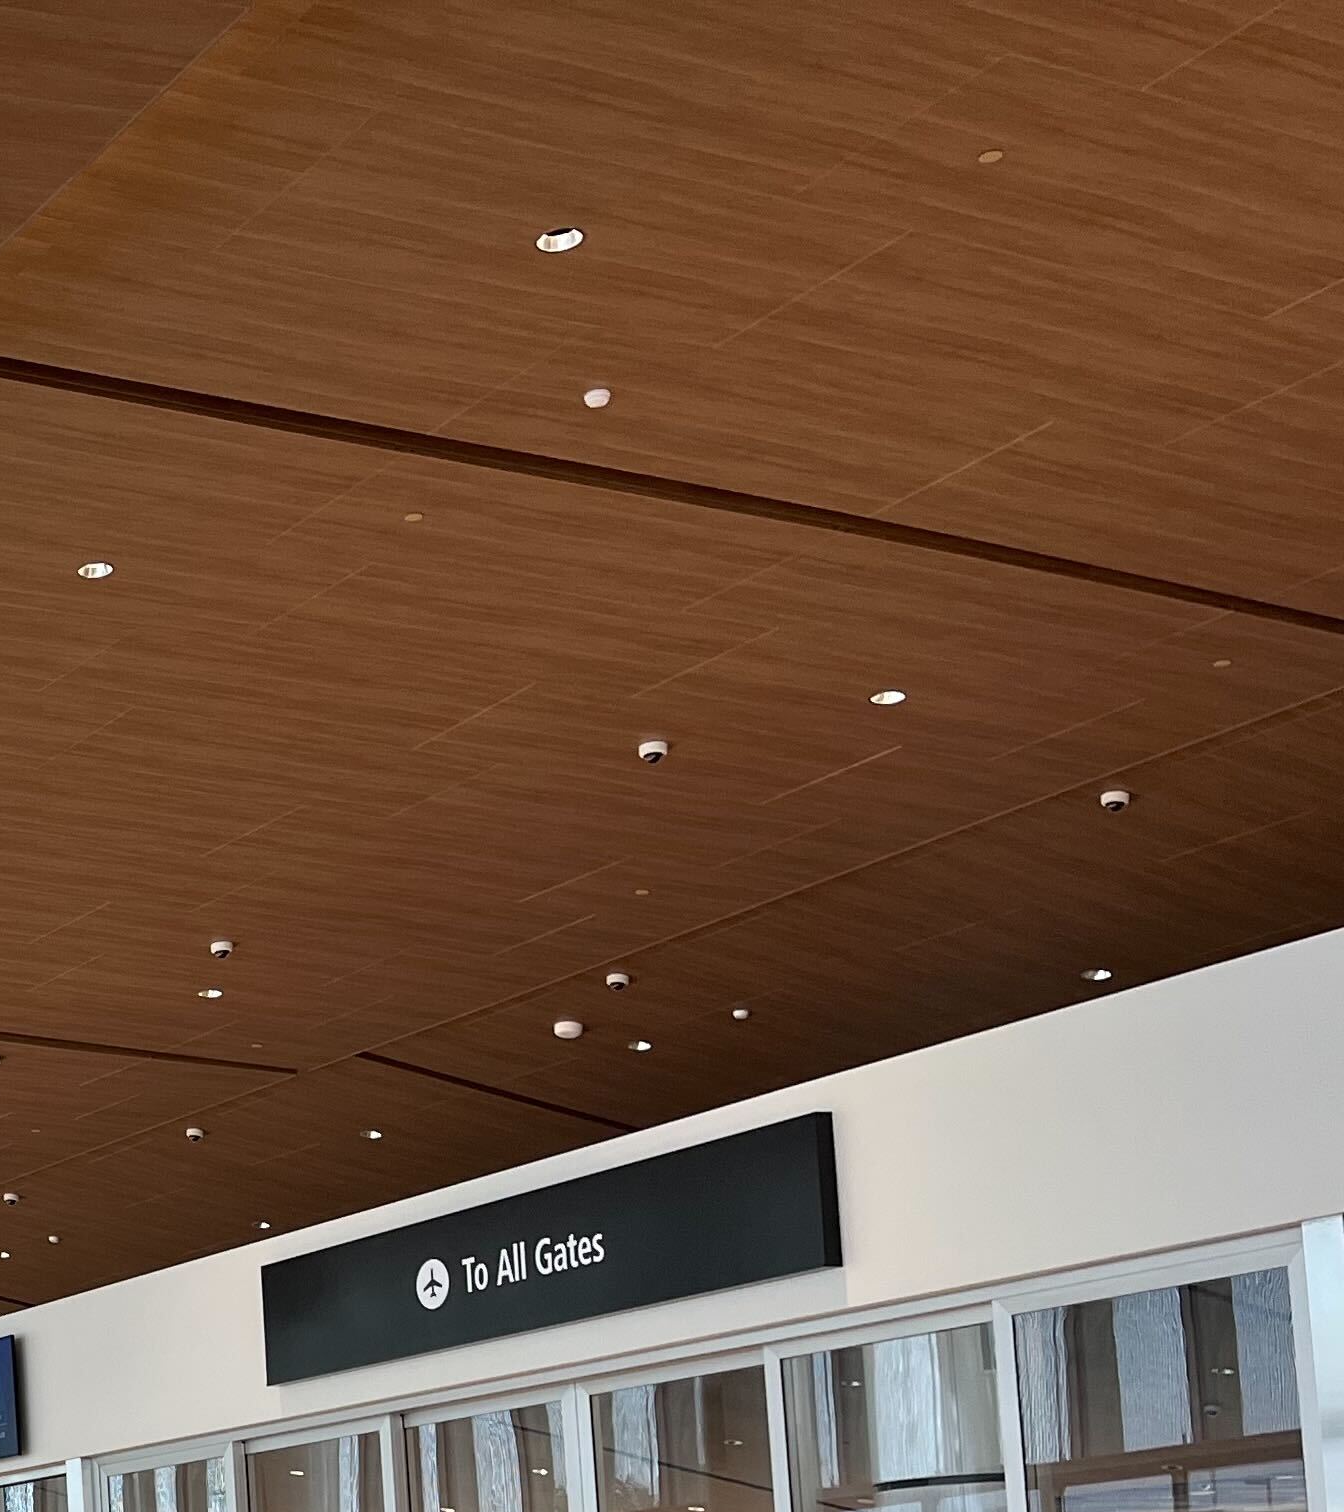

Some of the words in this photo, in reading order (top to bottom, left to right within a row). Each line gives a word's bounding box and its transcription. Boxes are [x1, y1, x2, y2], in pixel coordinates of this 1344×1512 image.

[461, 1256, 489, 1293] To
[496, 1241, 528, 1286] All
[534, 1233, 605, 1275] Gates
